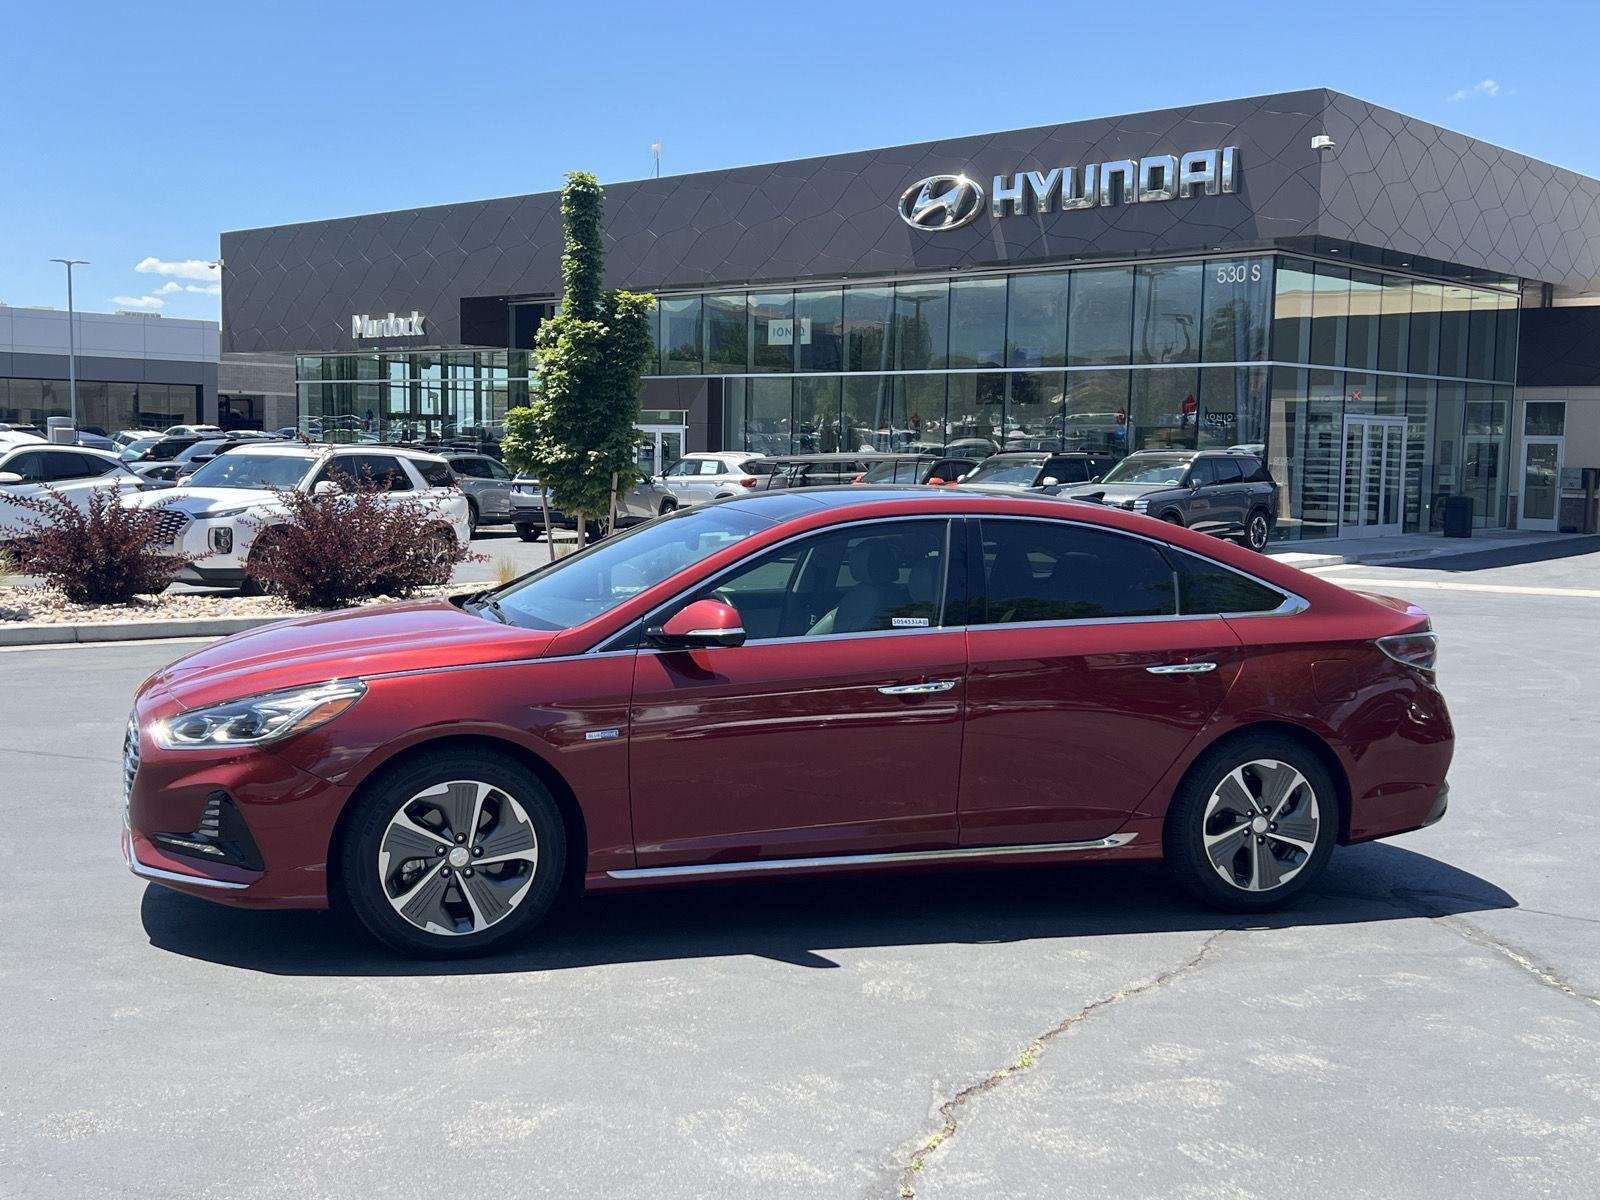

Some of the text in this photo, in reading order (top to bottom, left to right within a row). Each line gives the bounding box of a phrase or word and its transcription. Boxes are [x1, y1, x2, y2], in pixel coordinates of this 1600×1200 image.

[993, 146, 1239, 217] HYUNDAI
[1217, 264, 1261, 283] 530 S
[352, 311, 425, 339] Murdock
[772, 327, 806, 337] IONQ
